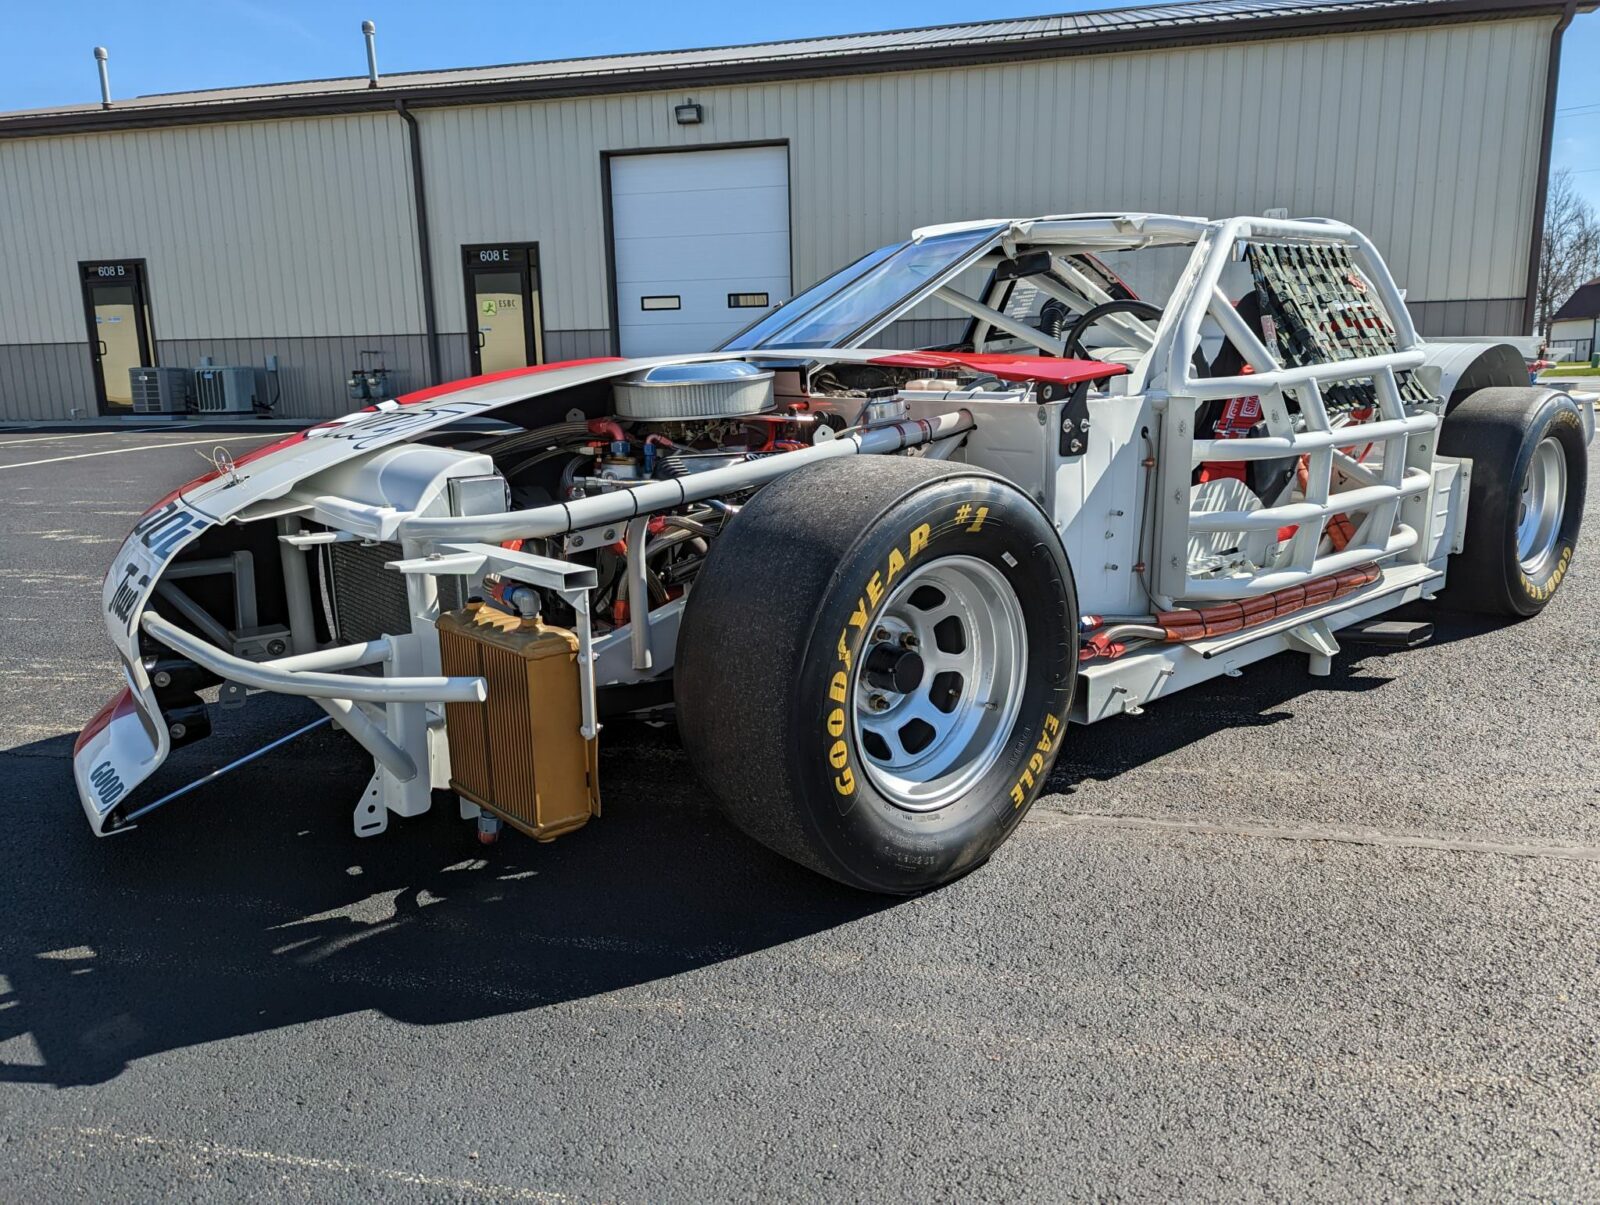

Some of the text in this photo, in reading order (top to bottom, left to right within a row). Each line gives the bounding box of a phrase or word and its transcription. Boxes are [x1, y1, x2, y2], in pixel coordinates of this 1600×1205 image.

[98, 265, 125, 276] 608 B
[480, 249, 510, 261] 608 E
[1010, 713, 1060, 809] EAGLE
[90, 760, 130, 815] GOOD
